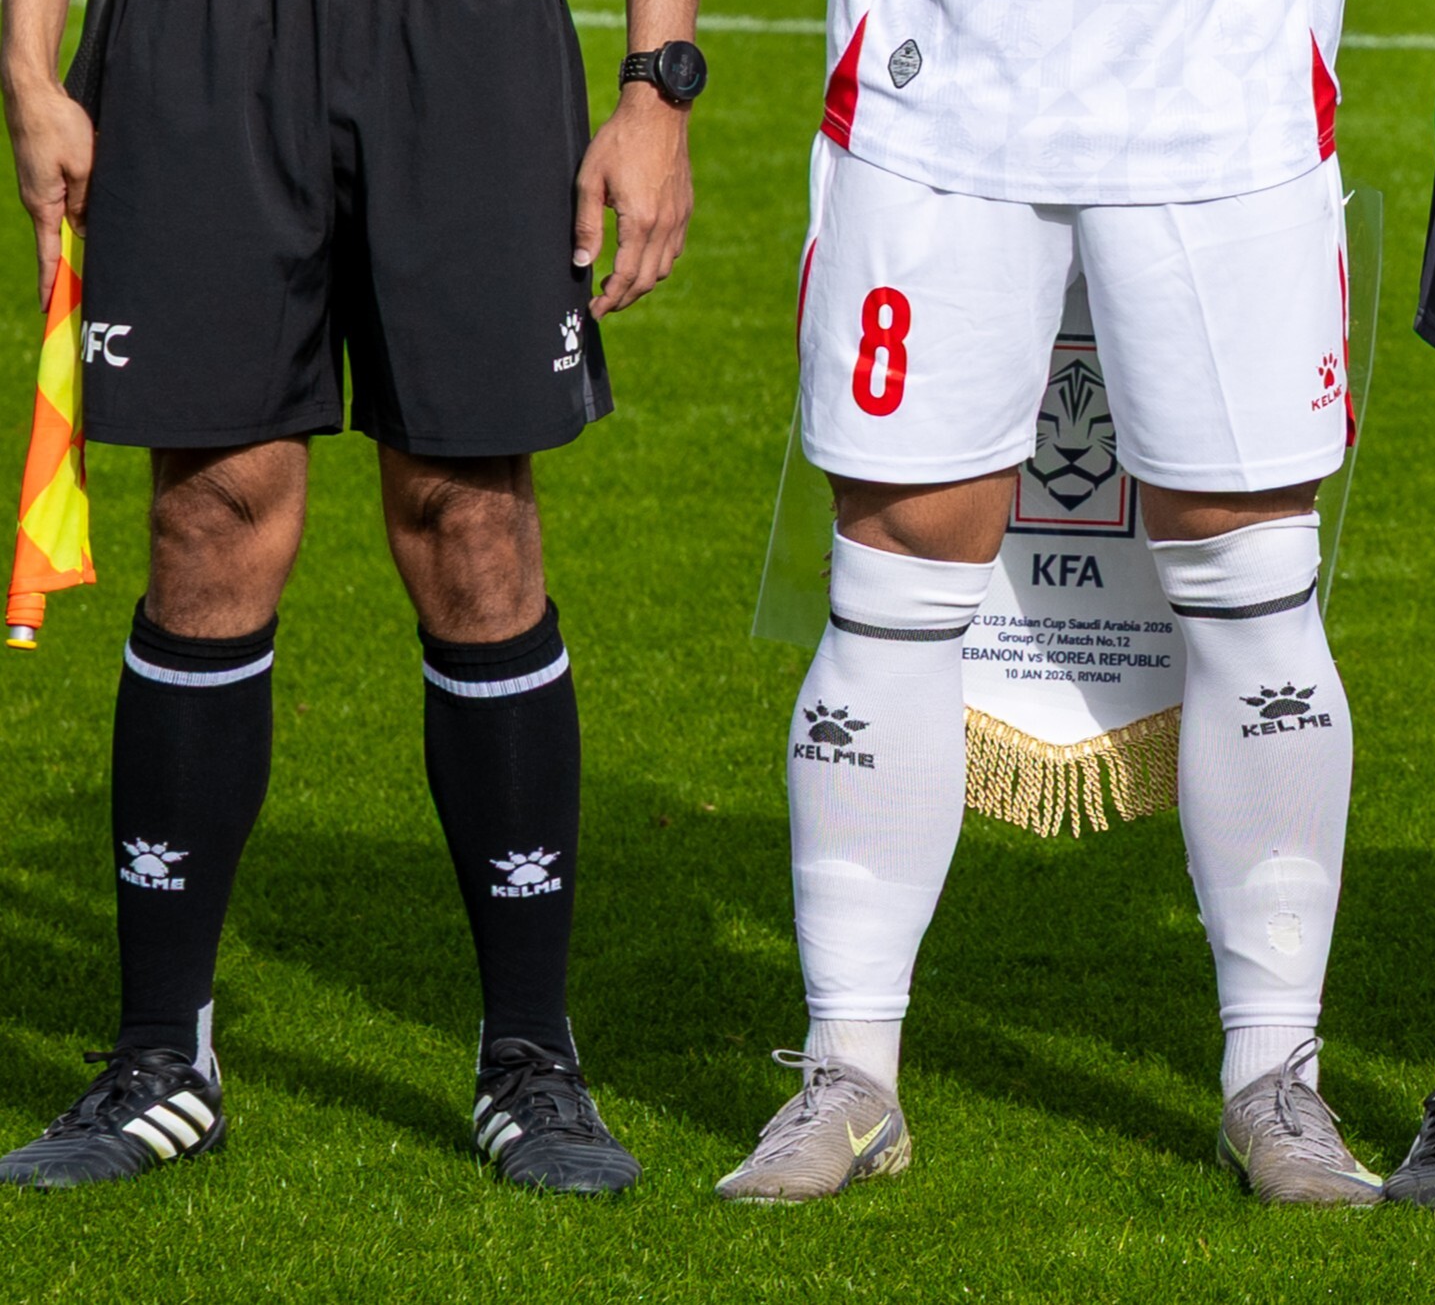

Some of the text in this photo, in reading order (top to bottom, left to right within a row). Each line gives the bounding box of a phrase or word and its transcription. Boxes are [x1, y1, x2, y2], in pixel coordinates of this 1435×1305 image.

[852, 287, 911, 416] 8
[1032, 553, 1104, 588] KFA
[984, 616, 1006, 626] U23
[1009, 617, 1040, 628] Asian
[1043, 618, 1066, 631] Cup
[1068, 618, 1100, 631] Saudi
[1103, 620, 1141, 632] Arabia
[1143, 622, 1173, 633] 2026
[998, 632, 1034, 645] Group
[1036, 633, 1045, 644] C
[1057, 635, 1092, 646] Match
[1096, 636, 1130, 647] No.12
[962, 647, 1171, 668] EBANON vs KOREA REPUBLIC
[1005, 669, 1121, 683] 10 JAN 2026, RIYADH
[1242, 712, 1333, 740] KELME
[793, 743, 876, 770] KELME
[120, 867, 186, 891] KELME
[491, 877, 563, 898] KELME
